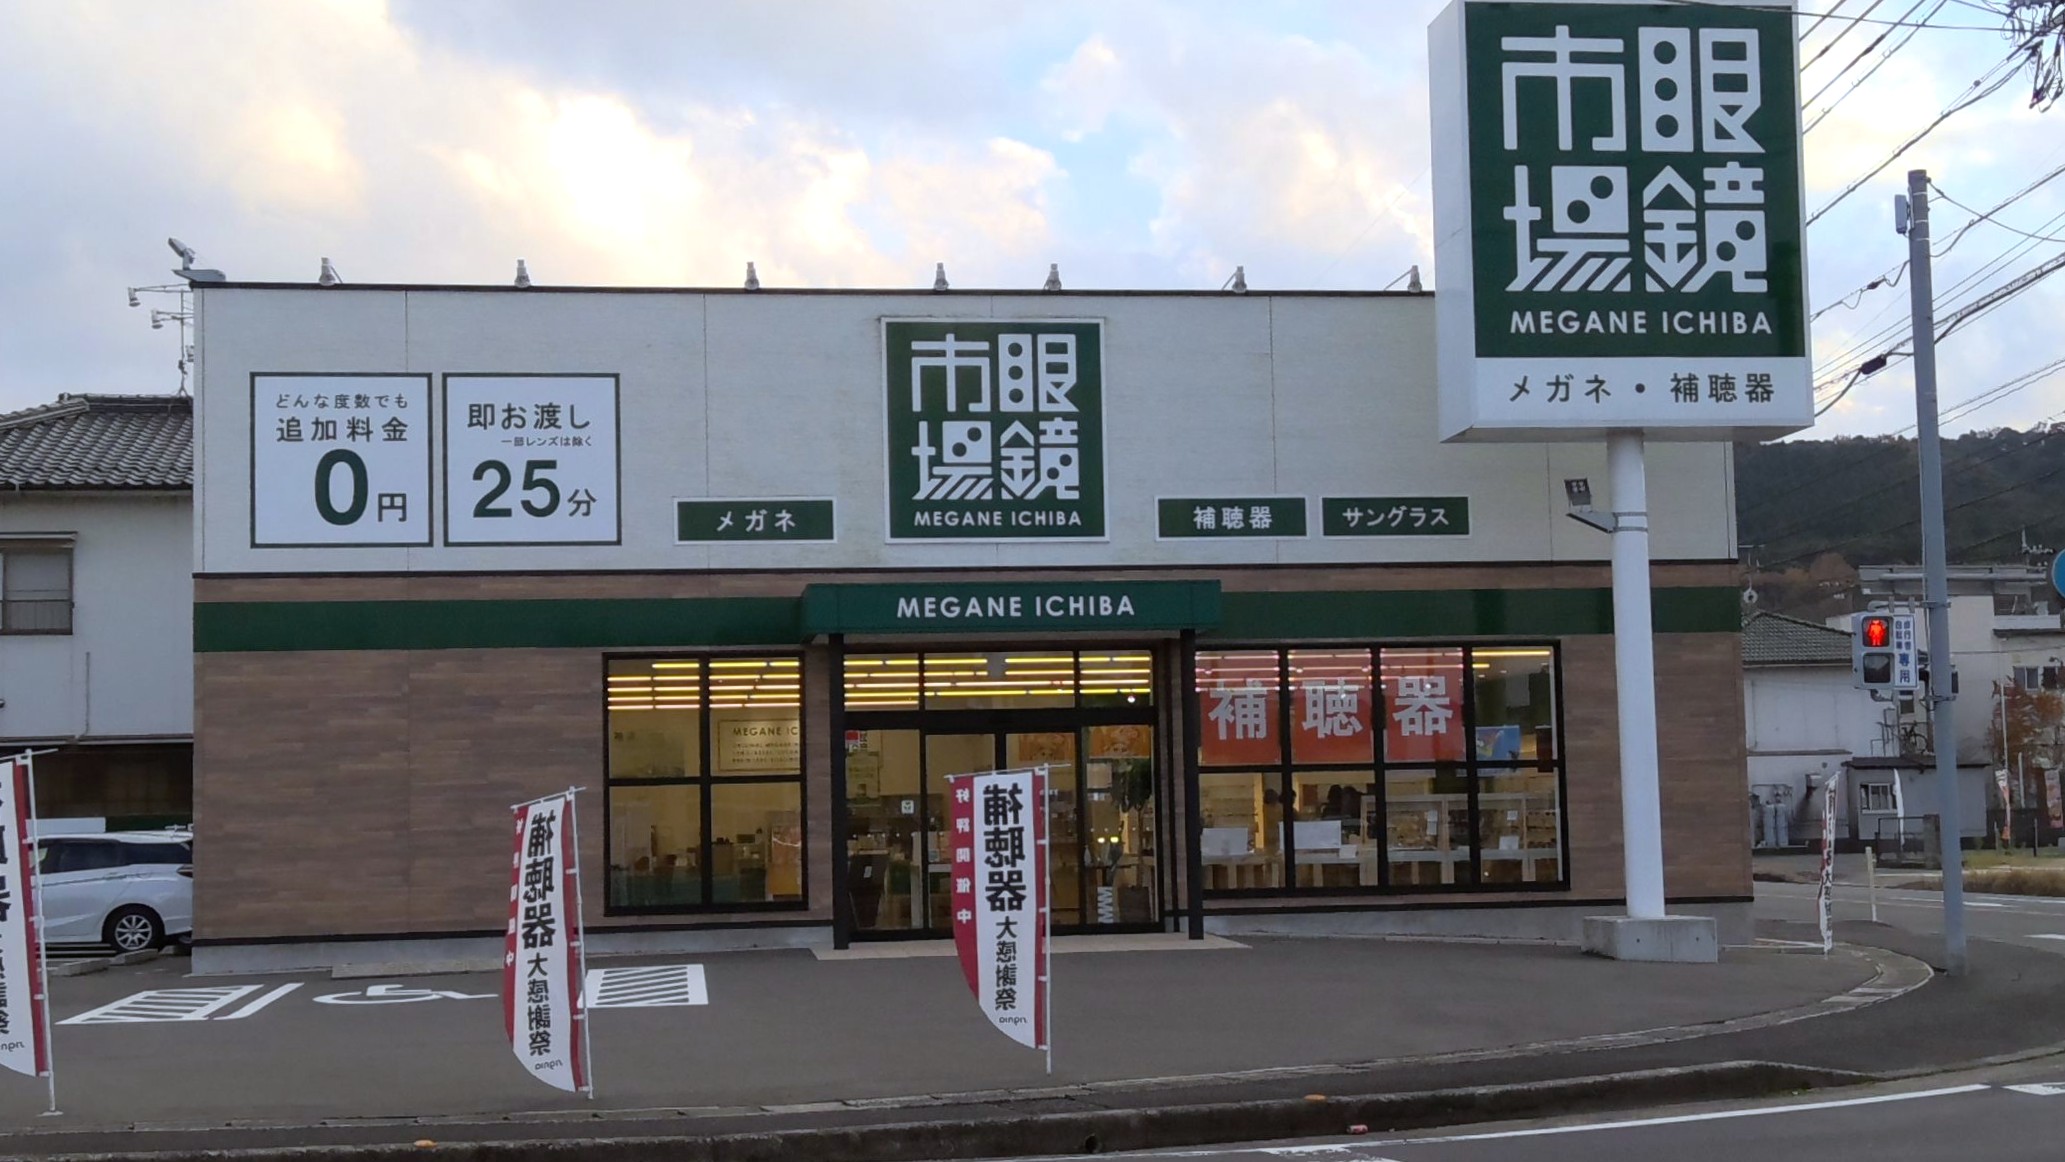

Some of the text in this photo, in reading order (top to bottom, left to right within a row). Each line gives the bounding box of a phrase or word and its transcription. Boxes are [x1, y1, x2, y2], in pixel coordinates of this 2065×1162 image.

[1509, 310, 1772, 334] MEGANE ICHIBA
[275, 393, 409, 409] どんな度数でも
[467, 402, 591, 430] 即お渡し
[276, 416, 409, 443] 追加料金
[716, 509, 797, 533] メガネ
[914, 511, 1081, 526] MEGANE ICHIBA
[1193, 506, 1273, 529] 補聴器
[1342, 505, 1449, 528] サングラス
[897, 595, 1136, 619] MEGANE ICHIBA
[1209, 675, 1453, 740] 補聴器
[733, 726, 782, 736] MEGANE
